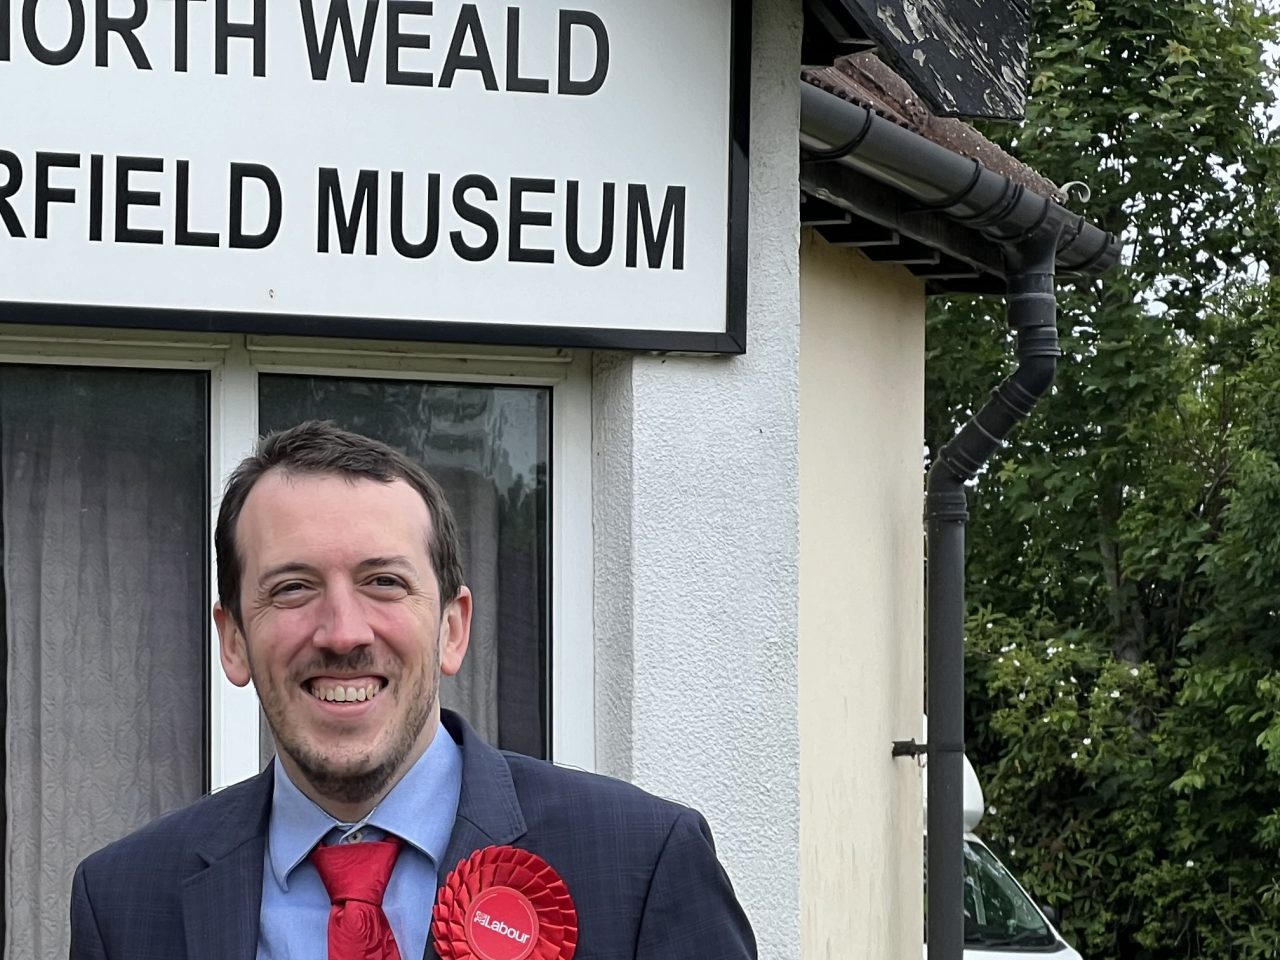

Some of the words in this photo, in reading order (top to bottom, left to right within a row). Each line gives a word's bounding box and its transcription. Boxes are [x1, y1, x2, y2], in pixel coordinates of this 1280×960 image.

[300, 0, 609, 96] WEALD
[318, 168, 686, 270] MUSEUM
[484, 914, 531, 944] Labour
